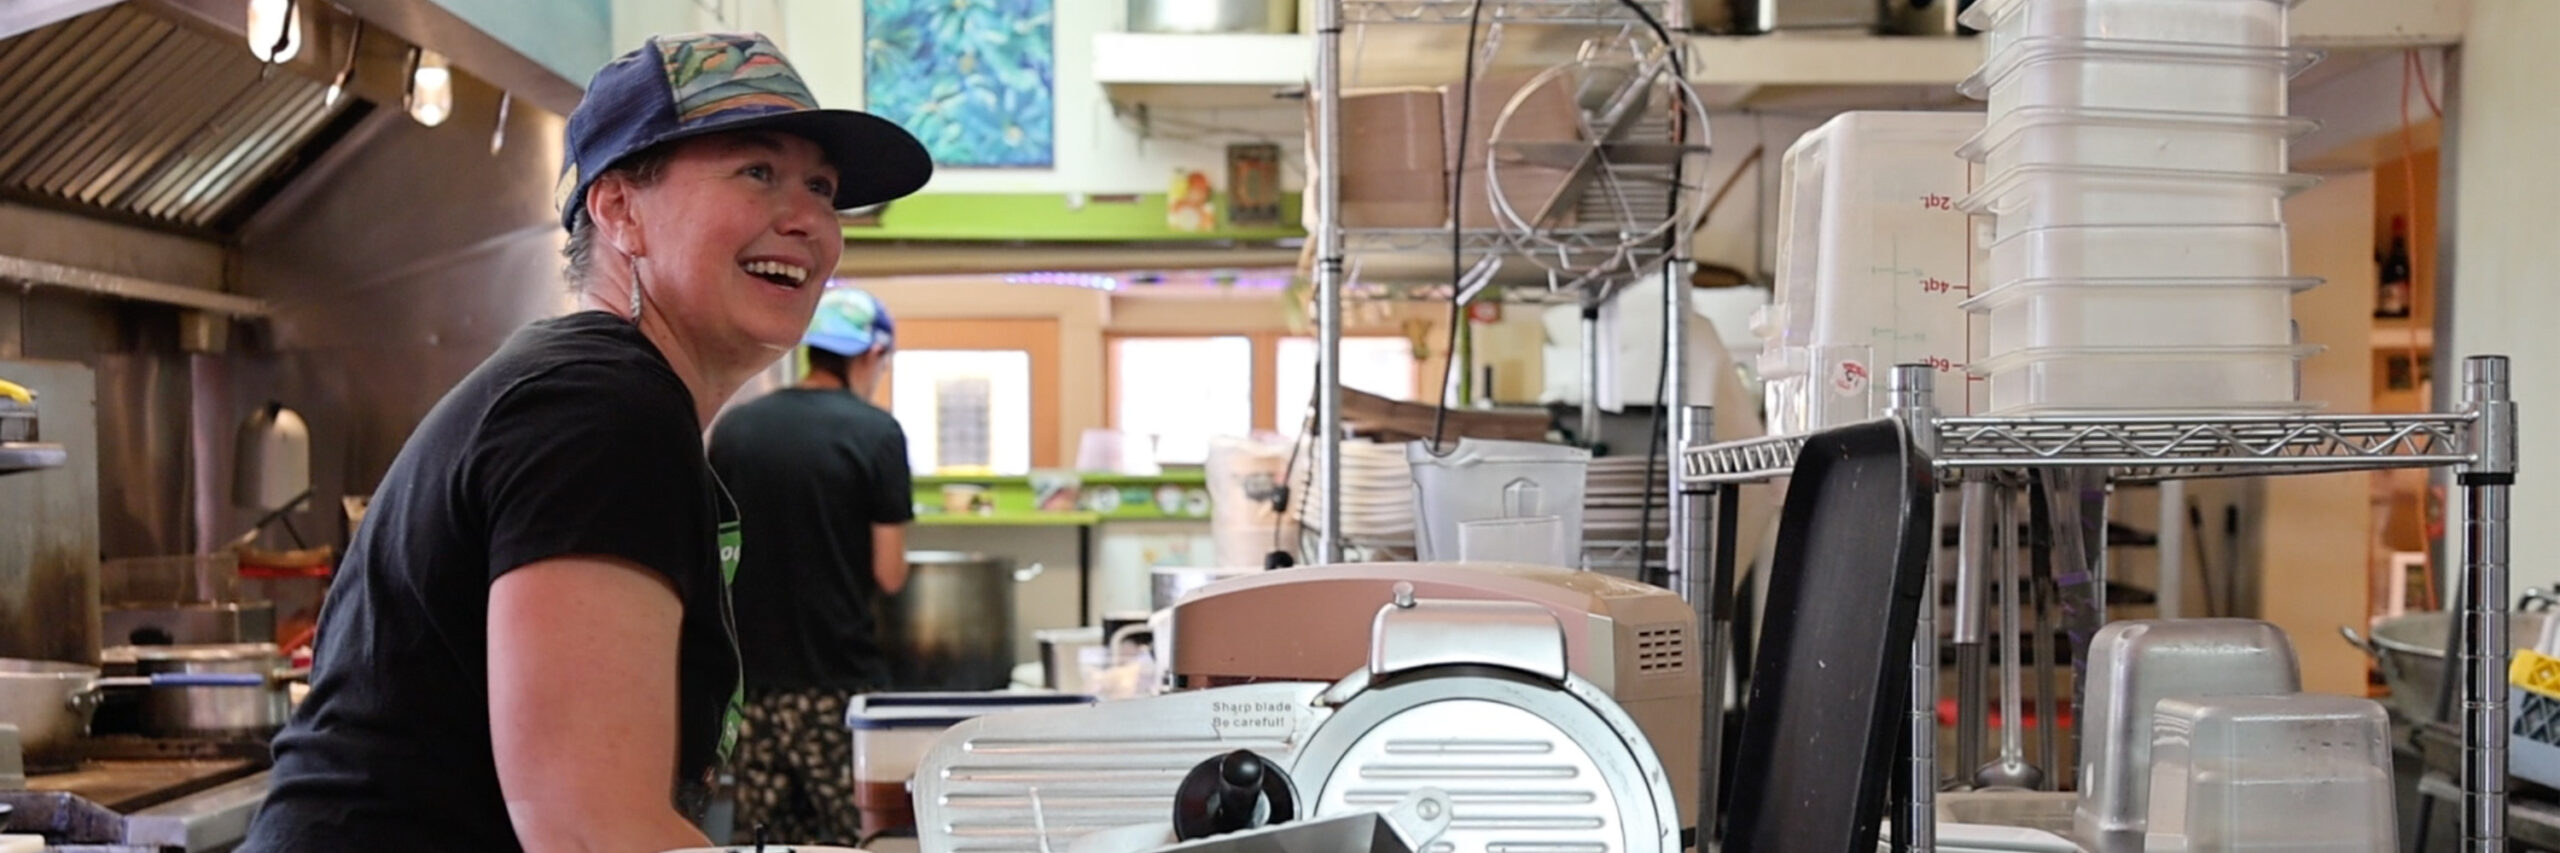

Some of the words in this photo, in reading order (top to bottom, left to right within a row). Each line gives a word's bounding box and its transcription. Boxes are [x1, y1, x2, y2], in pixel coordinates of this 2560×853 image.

[1920, 193, 1950, 210] 2qt.
[1919, 278, 1950, 293] 4qt.
[1212, 701, 1252, 713] Sharp
[1255, 702, 1292, 712] blade
[1212, 717, 1230, 727] Be
[1233, 717, 1284, 727] careful!
